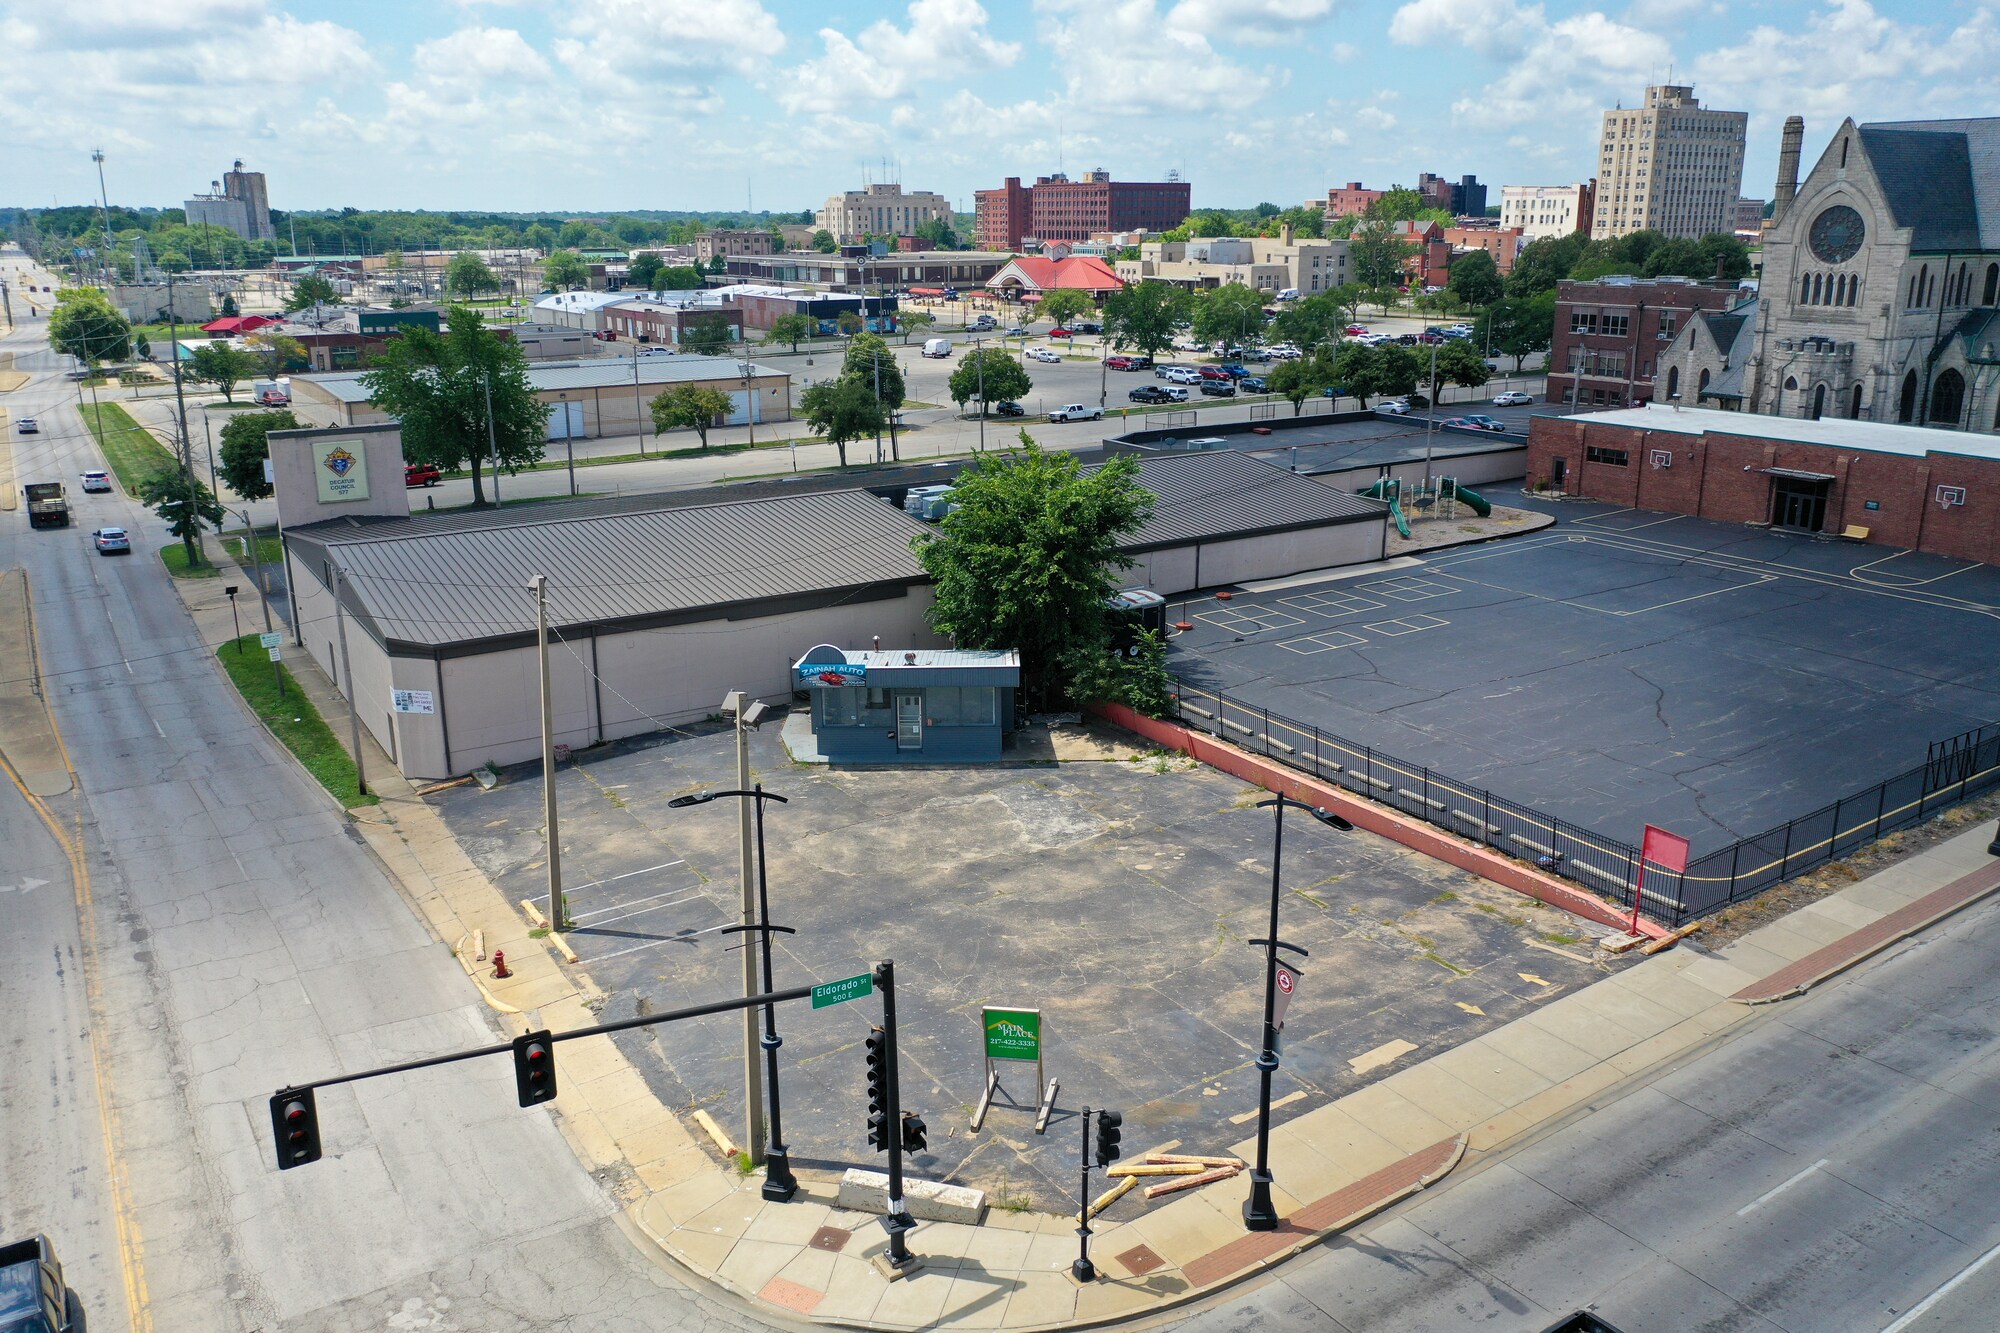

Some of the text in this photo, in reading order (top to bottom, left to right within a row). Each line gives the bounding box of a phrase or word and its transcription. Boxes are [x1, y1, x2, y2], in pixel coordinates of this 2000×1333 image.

[329, 478, 356, 486] DECATUR
[801, 665, 864, 676] ZAINAH AUTO
[816, 980, 858, 997] Eldorado
[832, 993, 847, 1002] 500
[997, 1023, 1024, 1032] MAIN
[1002, 1029, 1034, 1038] PLACE
[990, 1037, 1036, 1047] 217-422-3335
